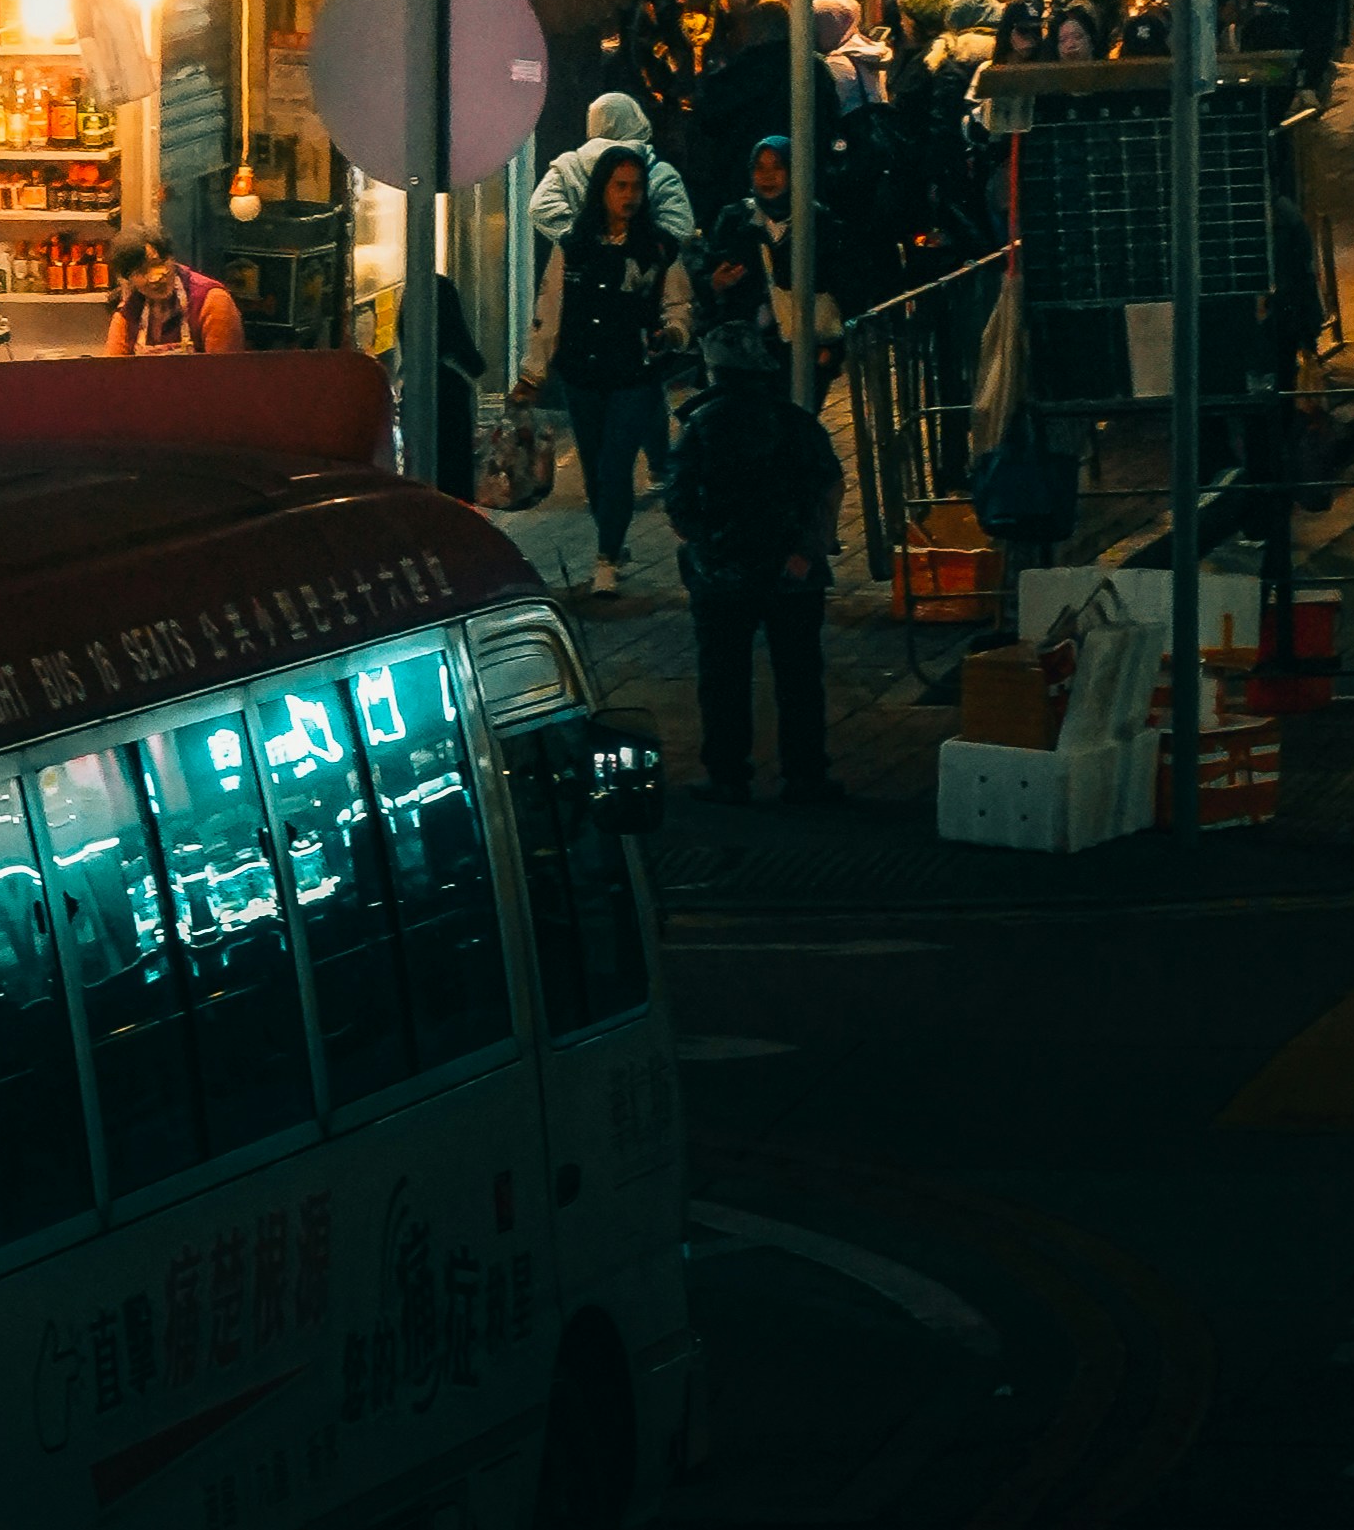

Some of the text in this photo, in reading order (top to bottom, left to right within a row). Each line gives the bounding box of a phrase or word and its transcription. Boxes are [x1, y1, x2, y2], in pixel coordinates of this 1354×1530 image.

[39, 645, 86, 712] BUS
[93, 637, 125, 695] 16
[120, 618, 200, 685] SEATS
